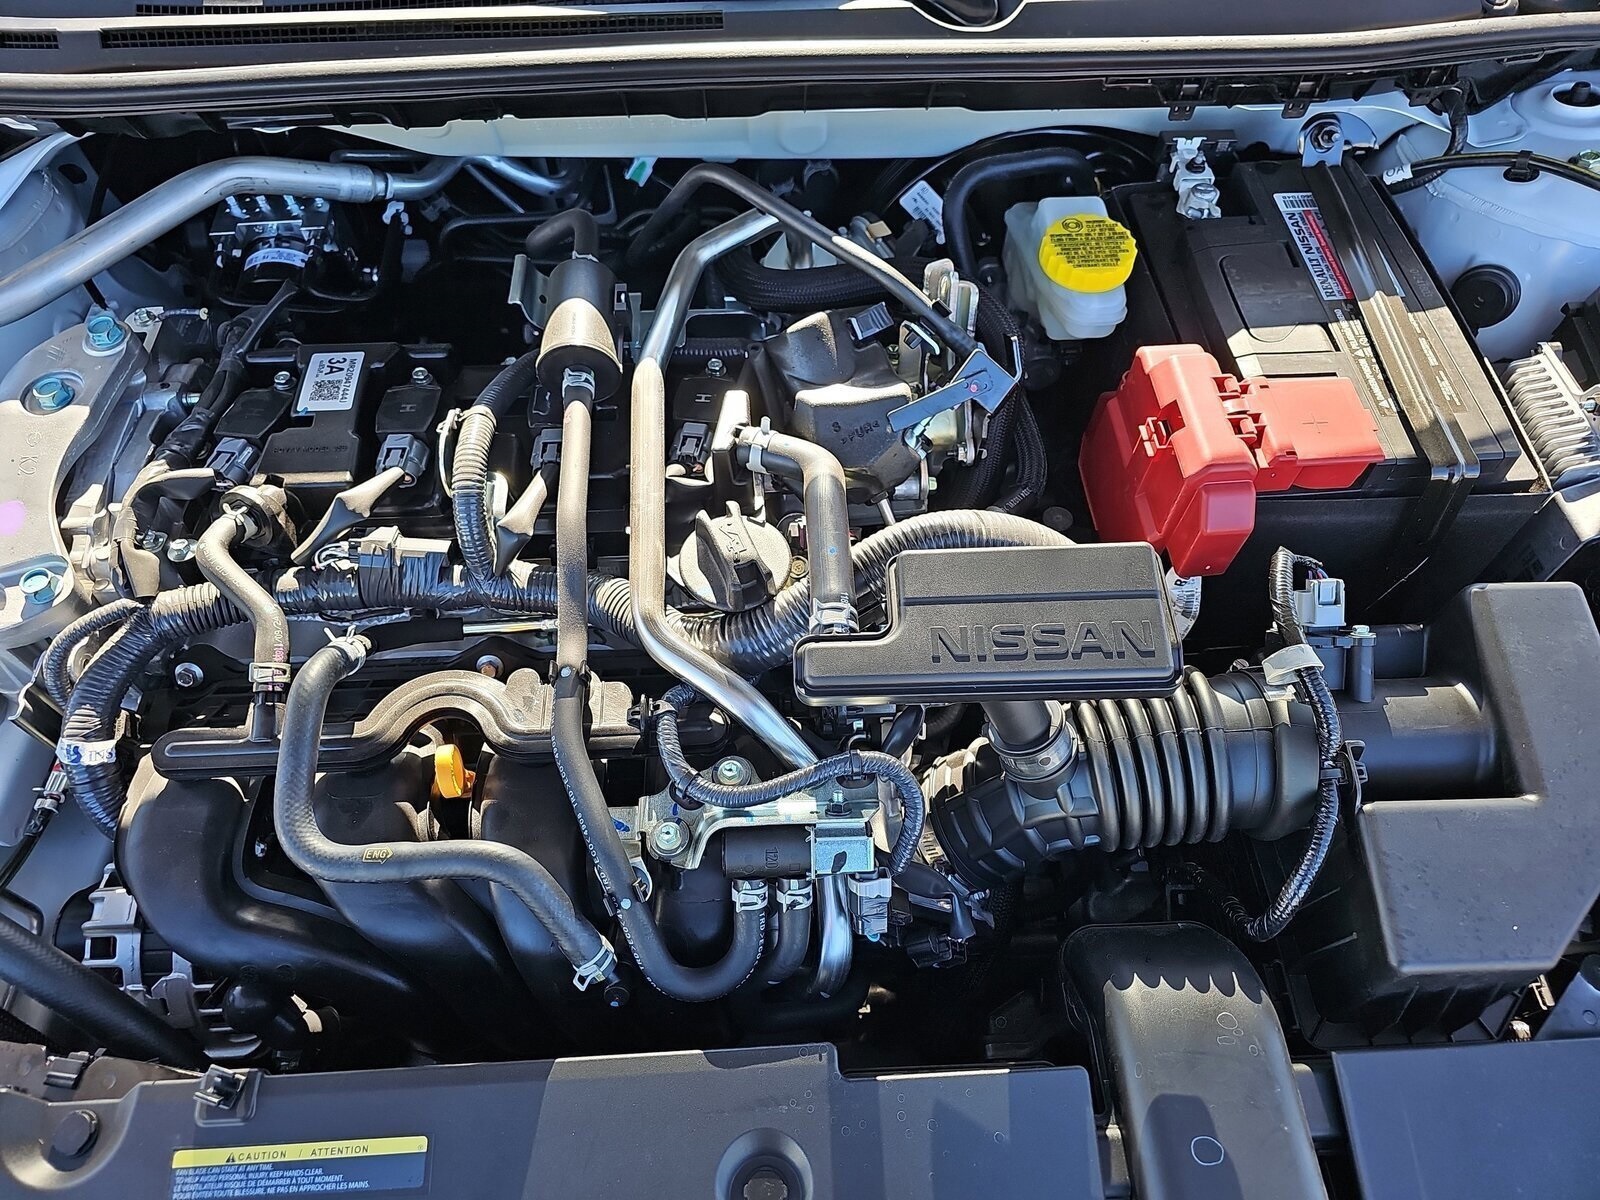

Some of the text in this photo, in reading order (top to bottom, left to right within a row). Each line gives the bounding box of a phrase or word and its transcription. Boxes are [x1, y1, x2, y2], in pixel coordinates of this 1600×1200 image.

[1286, 212, 1315, 255] NISSAN
[1308, 257, 1338, 298] RENAULT
[324, 357, 347, 375] 3A
[930, 620, 1156, 664] NISSAN
[365, 849, 388, 859] ENG
[238, 1150, 287, 1160] CAUTION
[310, 1145, 369, 1156] ATTENTION
[248, 1179, 257, 1187] DE
[297, 1175, 314, 1183] TOUT
[269, 1170, 283, 1178] KEEP
[284, 1169, 304, 1177] HANDS
[289, 1185, 298, 1193] EN
[299, 1183, 336, 1192] APPROCHER
